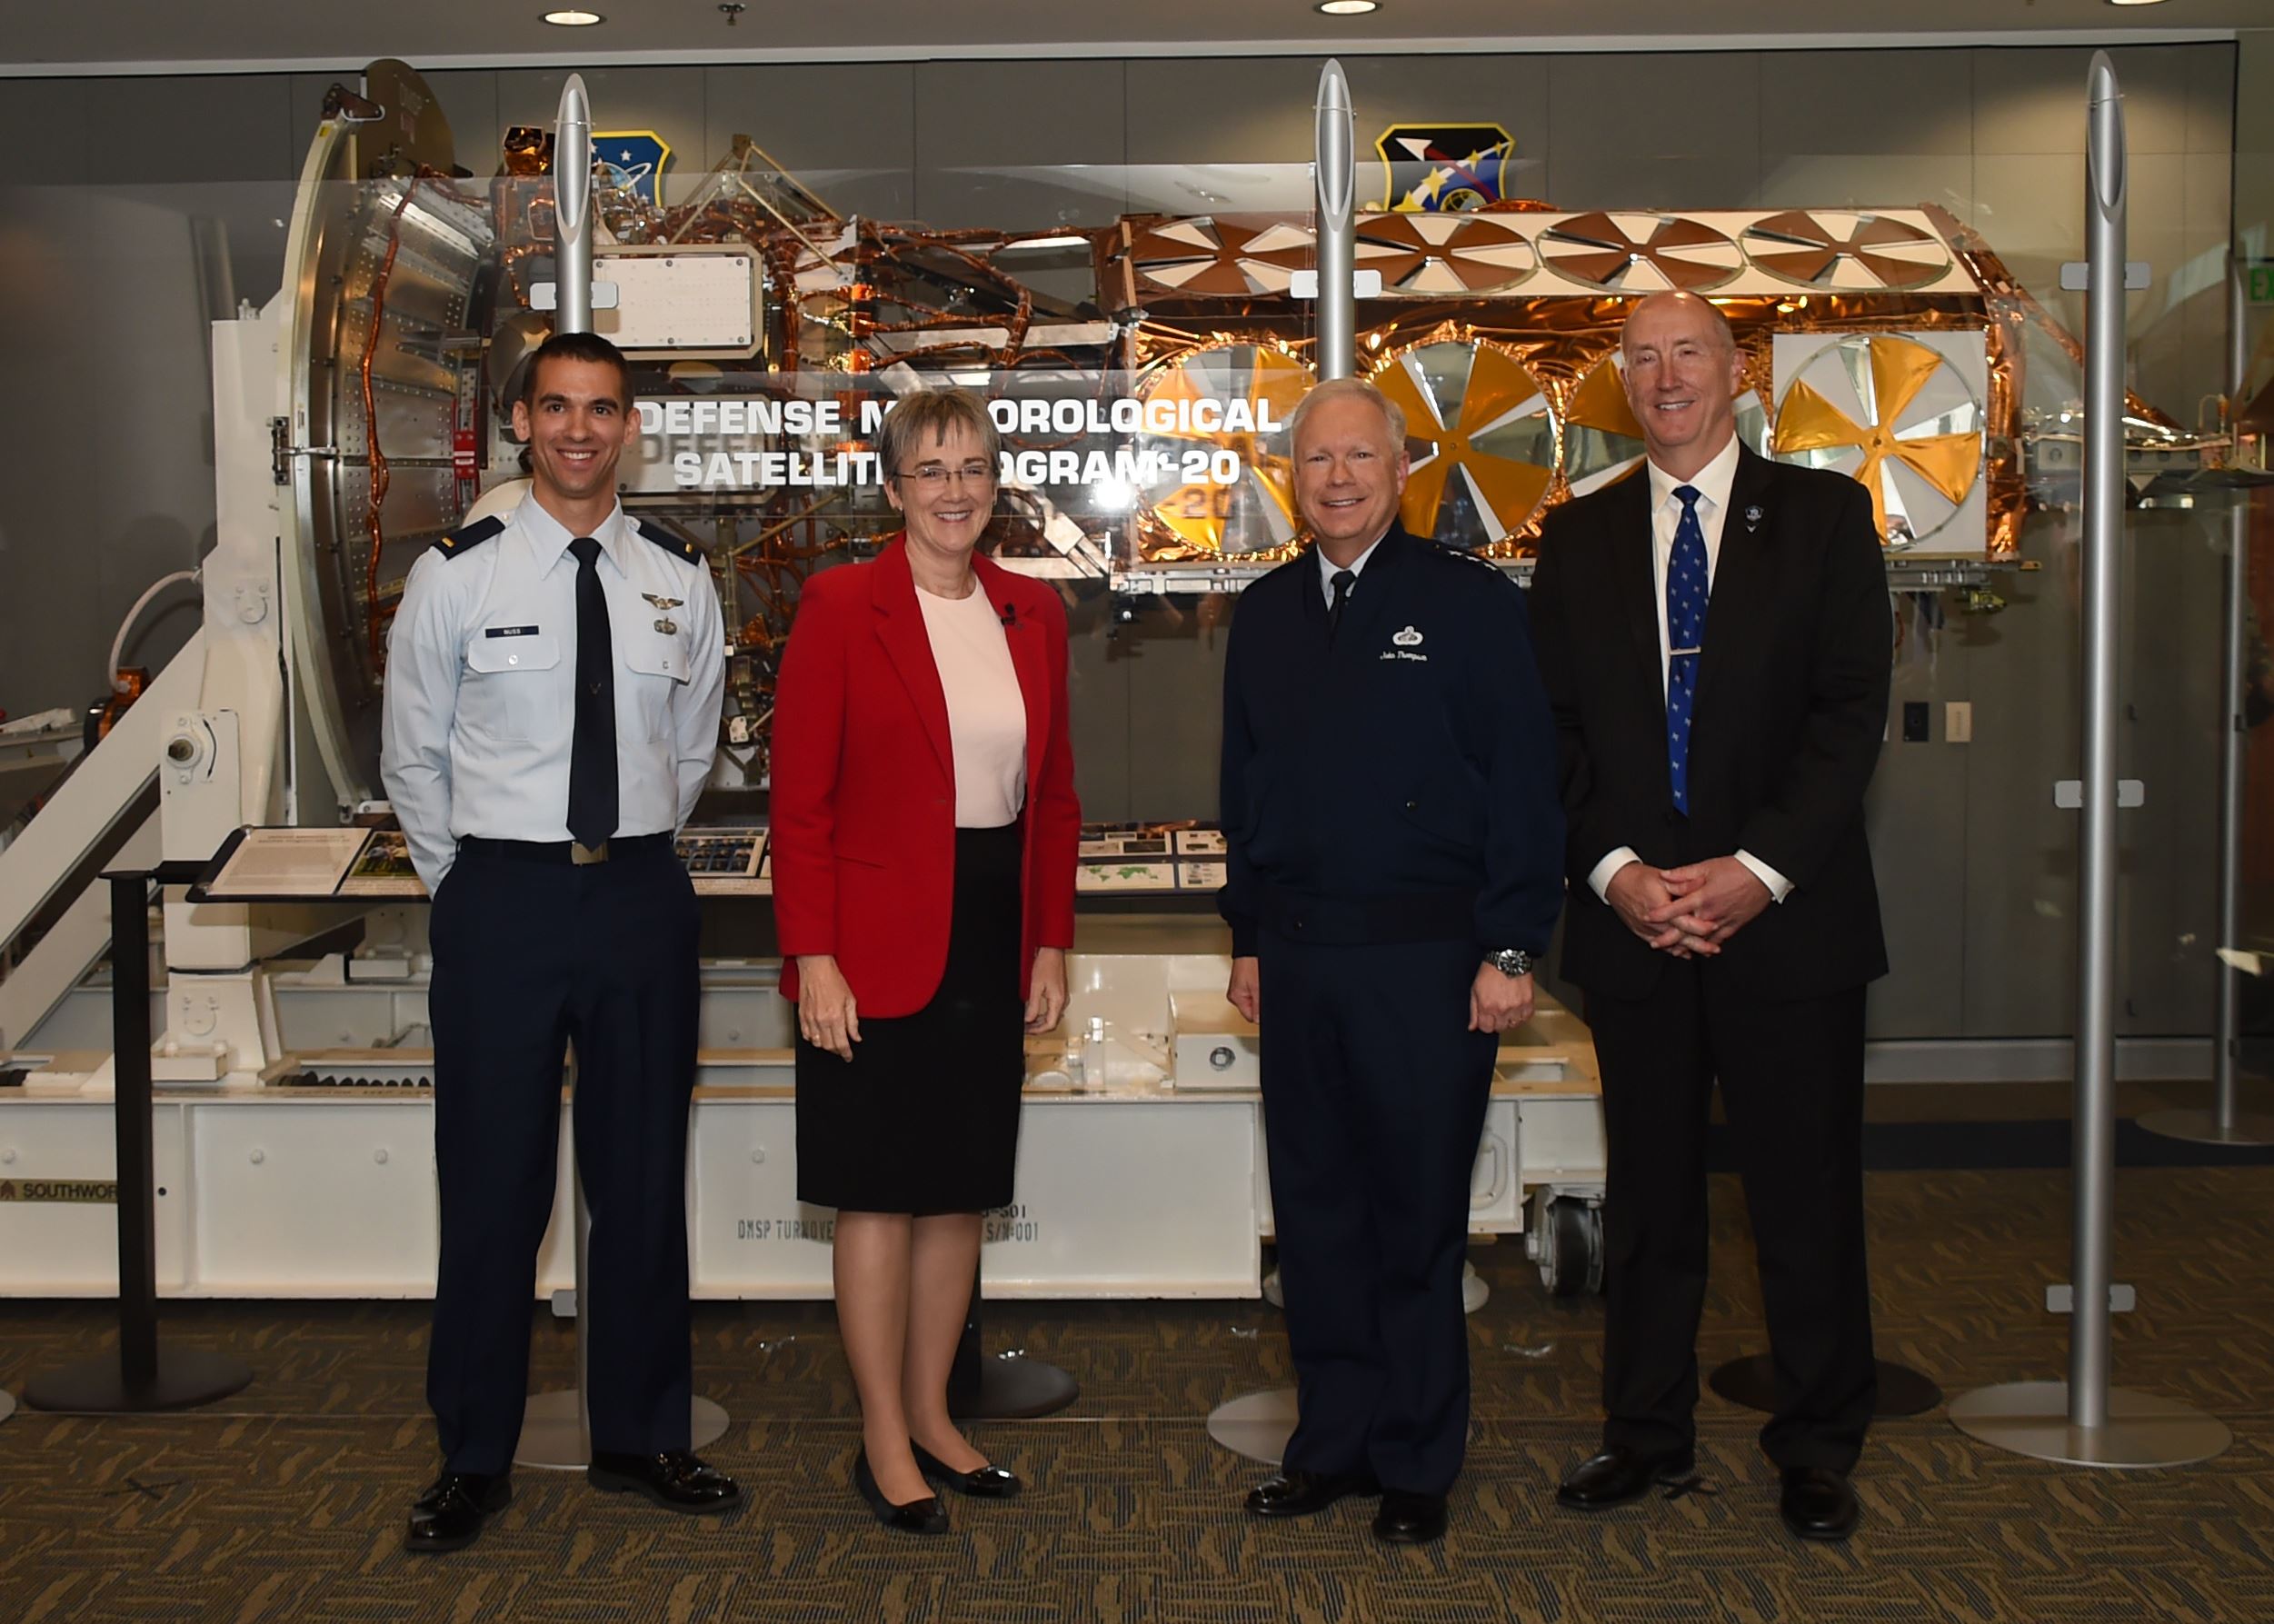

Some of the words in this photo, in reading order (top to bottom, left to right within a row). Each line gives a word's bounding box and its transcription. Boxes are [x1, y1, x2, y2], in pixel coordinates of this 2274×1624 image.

[2250, 268, 2274, 301] EX
[633, 401, 841, 434] DEFENSE
[861, 398, 1282, 433] MOROLOGICAL
[999, 450, 1240, 484] GRAM-20
[24, 1183, 118, 1200] SOUTHWOR
[737, 1220, 771, 1240] DMSP
[775, 1220, 834, 1240] TURNOVE
